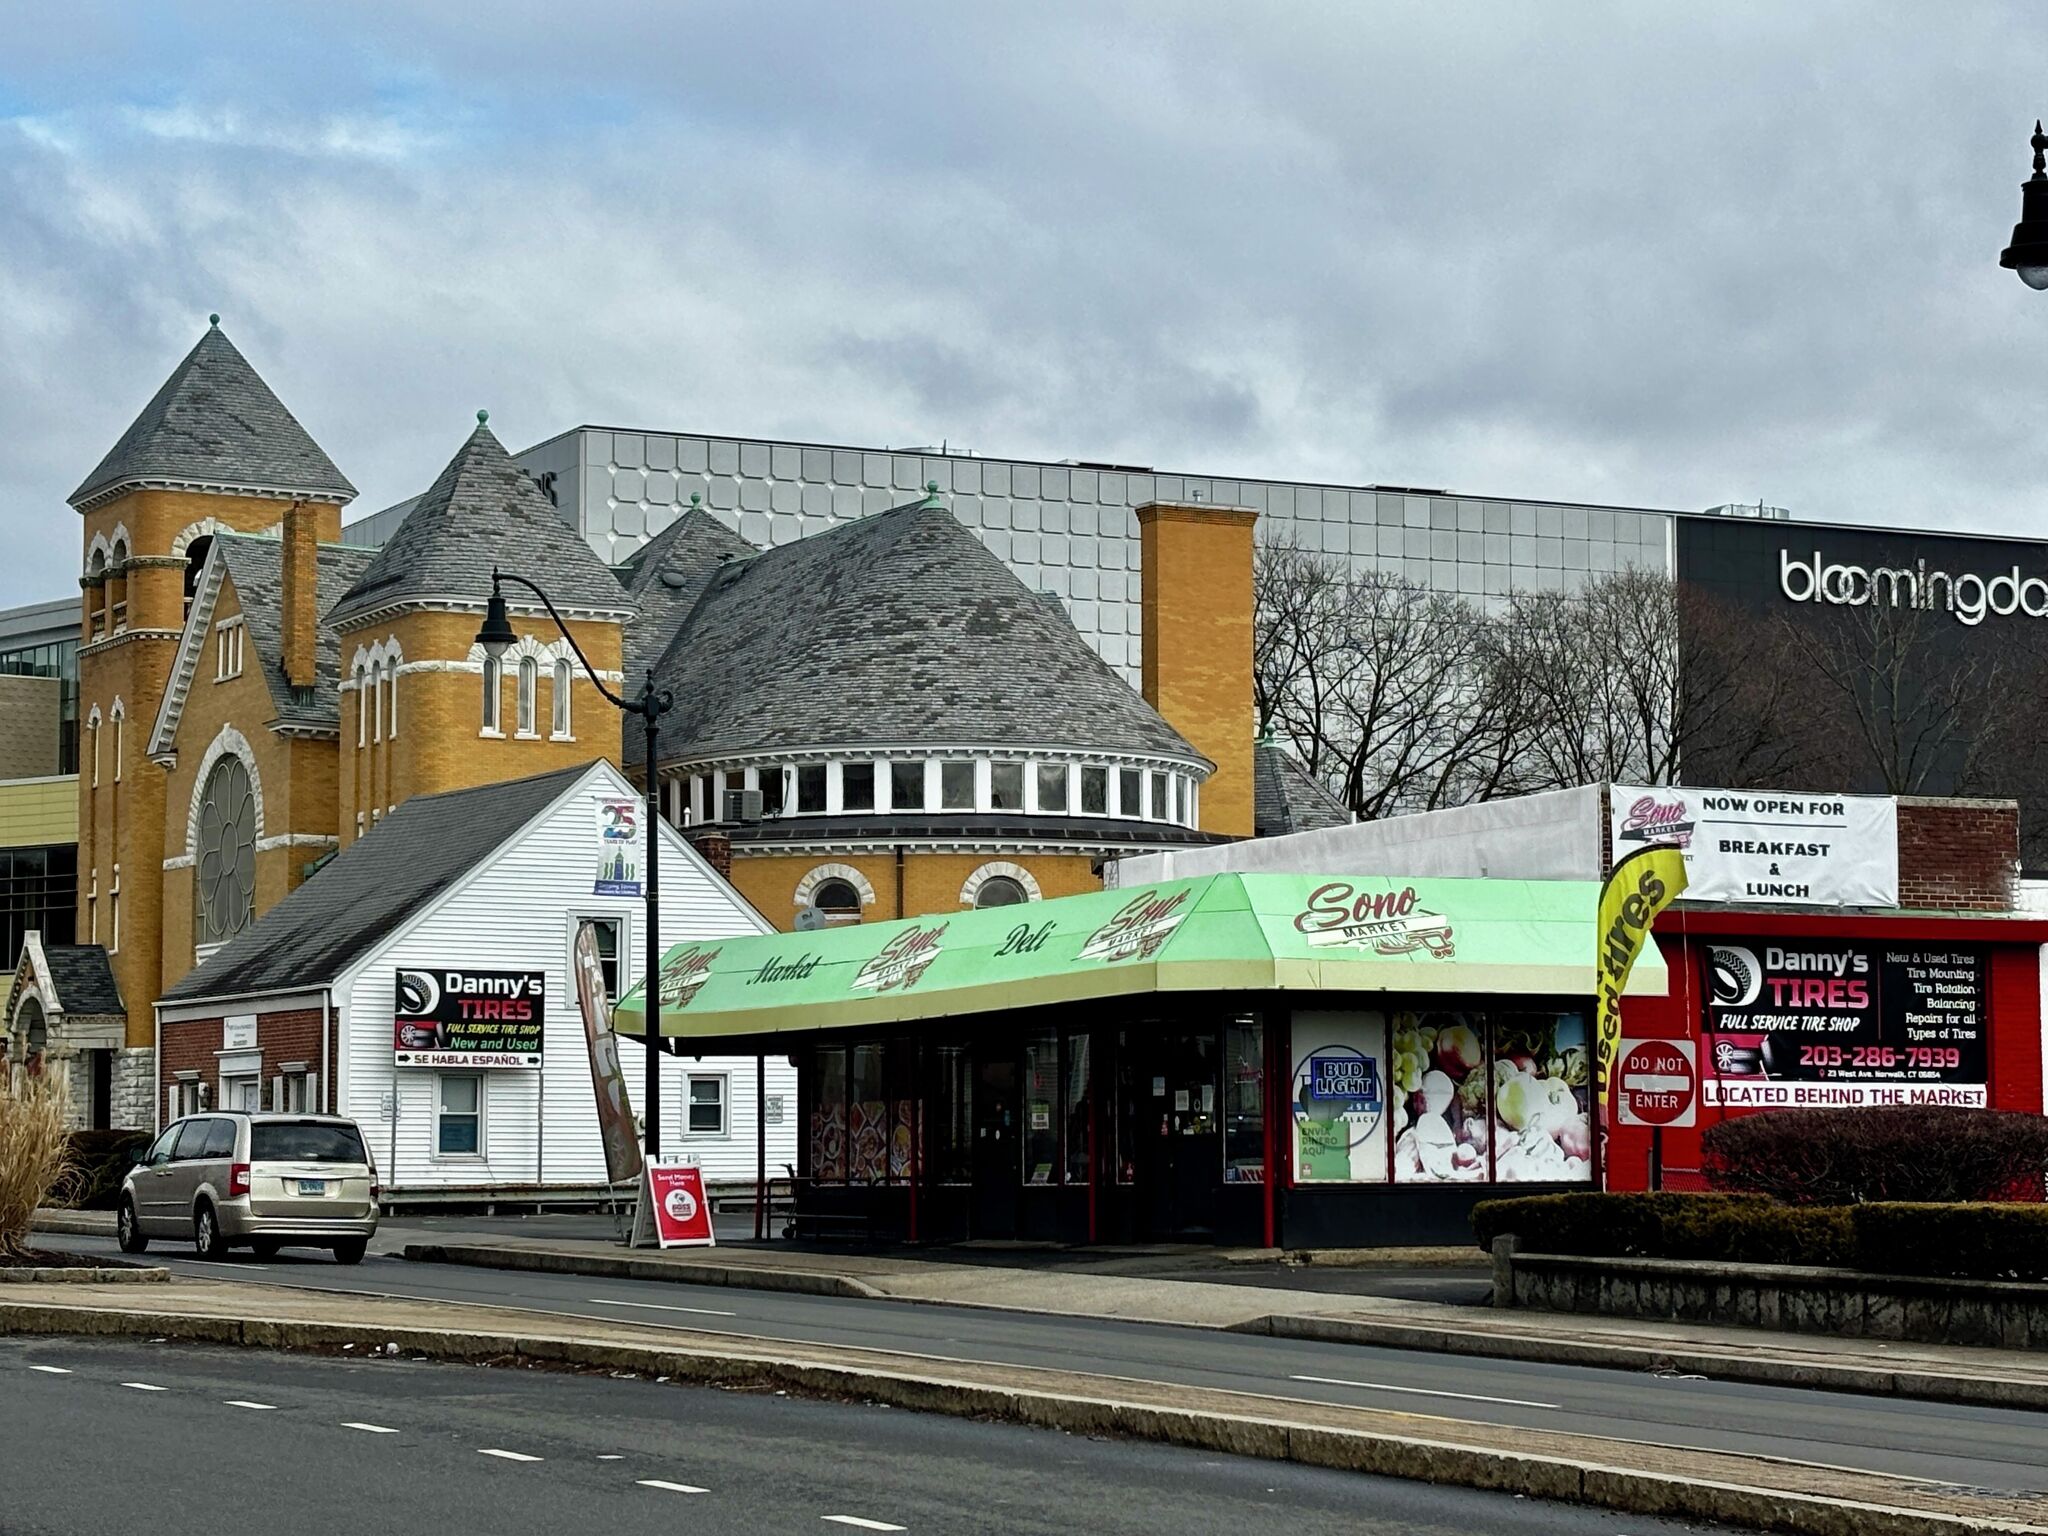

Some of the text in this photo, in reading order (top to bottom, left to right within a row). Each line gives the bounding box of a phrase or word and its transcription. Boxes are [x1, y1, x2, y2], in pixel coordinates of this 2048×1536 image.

[1620, 795, 1687, 832] Sono
[1703, 797, 1845, 816] NOW OPEN FOR
[601, 804, 637, 840] 25
[1643, 825, 1678, 836] MARKET
[1719, 839, 1831, 857] BREAKFAST
[1769, 862, 1781, 876] &
[1746, 883, 1810, 898] LUNCH
[1294, 883, 1422, 932] Sono
[1343, 920, 1409, 938] MARKET
[993, 919, 1057, 957] Deli
[1766, 947, 1869, 977] Danny's
[1886, 952, 1975, 964] New & Used Tires
[746, 952, 823, 985] Market
[1907, 967, 1975, 982] Tire Mounting
[445, 972, 543, 999] Danny's
[1767, 977, 1869, 1009] TIRES
[1913, 983, 1976, 994] Tire Rotation
[458, 1000, 532, 1021] TIRES
[1926, 998, 1976, 1012] Balancing
[1720, 1013, 1860, 1032] FULL SERVICE TIRE SHOP
[1905, 1012, 1976, 1025] Repairs for all
[446, 1023, 541, 1035] FULL SERVICE TIRE SHOP
[1907, 1028, 1977, 1041] Types of Tires
[450, 1037, 538, 1050] New and Used
[414, 1054, 523, 1066] SE HABLA ESPAÑOL
[1630, 1056, 1684, 1072] DO NOT
[1800, 1045, 1960, 1068] 203-286-7939
[1324, 1062, 1364, 1078] BUD
[1316, 1078, 1371, 1095] LIGHT
[1635, 1094, 1678, 1109] ENTER
[1705, 1087, 1985, 1105] LOCATED BEHIND THE MARKET
[1302, 1136, 1338, 1145] DINERO
[657, 1173, 673, 1181] Send
